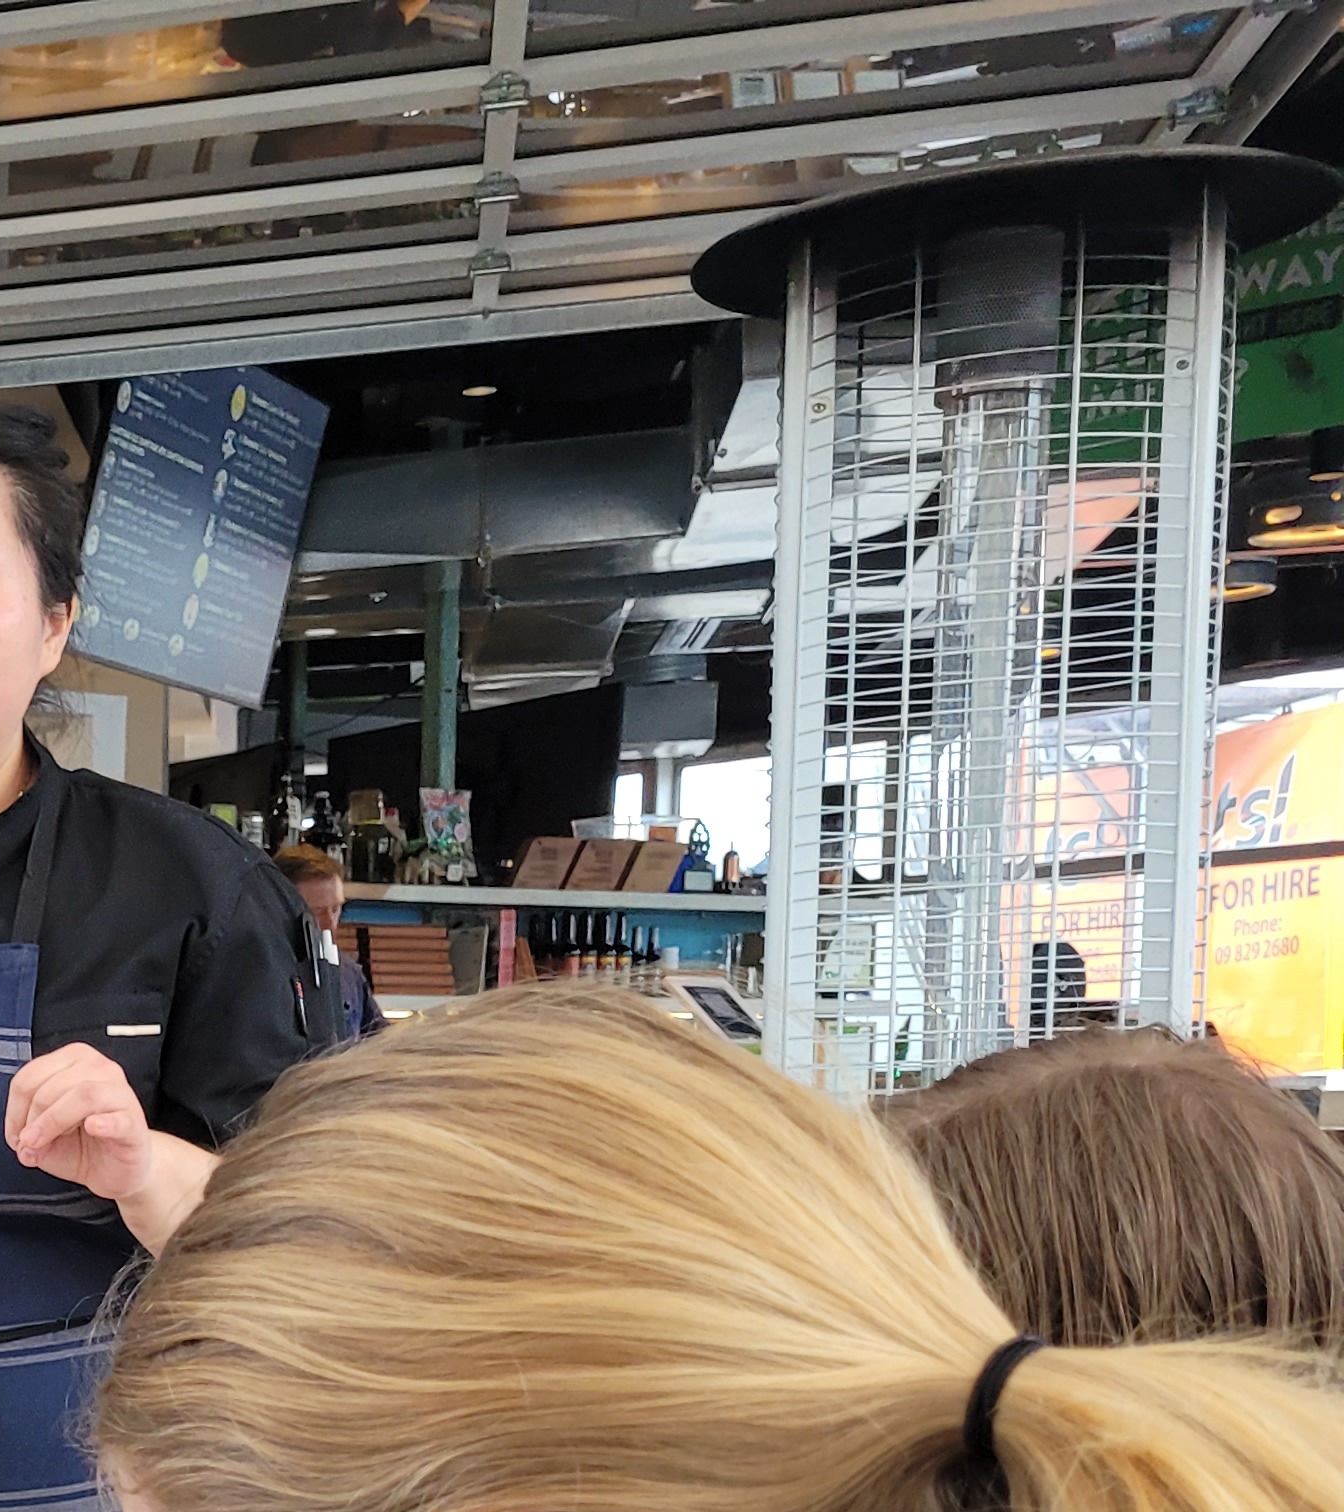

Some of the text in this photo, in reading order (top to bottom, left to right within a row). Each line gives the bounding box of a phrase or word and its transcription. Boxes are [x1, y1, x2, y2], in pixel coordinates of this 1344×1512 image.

[1210, 864, 1320, 912] FOR HIRE
[1233, 917, 1282, 936] Phone:
[1215, 935, 1299, 965] 09 829 2680
